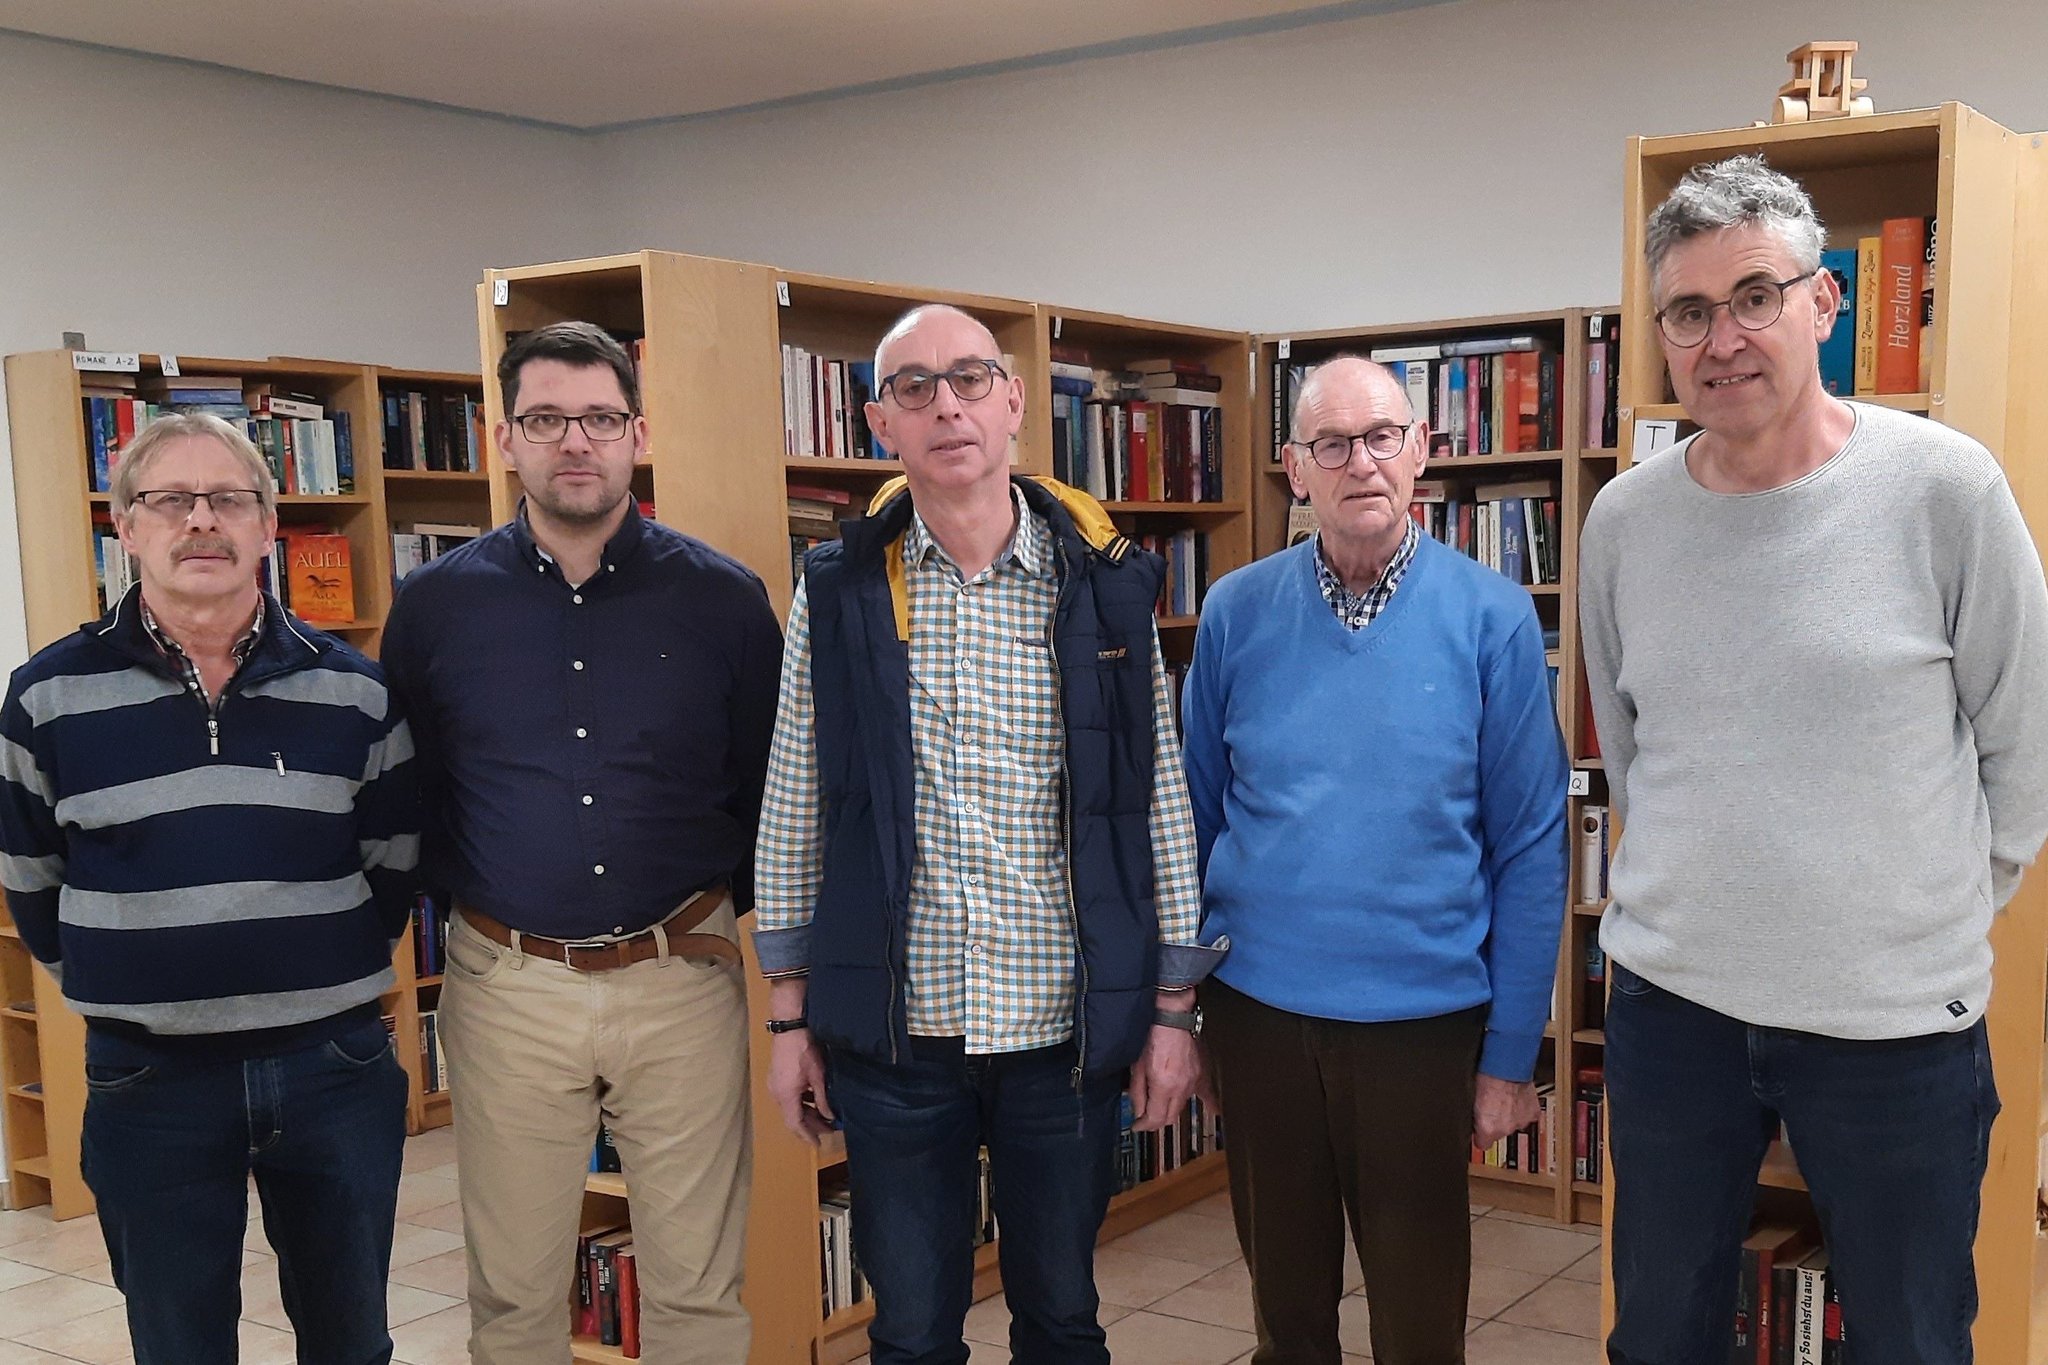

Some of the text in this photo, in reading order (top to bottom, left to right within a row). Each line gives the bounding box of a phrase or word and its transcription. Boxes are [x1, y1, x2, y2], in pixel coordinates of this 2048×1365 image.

[779, 286, 788, 300] K
[1888, 264, 1912, 349] Herzland
[1593, 322, 1601, 333] N
[1280, 344, 1289, 354] M
[116, 356, 136, 366] A-Z
[164, 360, 175, 372] A
[1645, 425, 1667, 450] T
[295, 551, 349, 569] AUEL
[1571, 777, 1582, 791] Q
